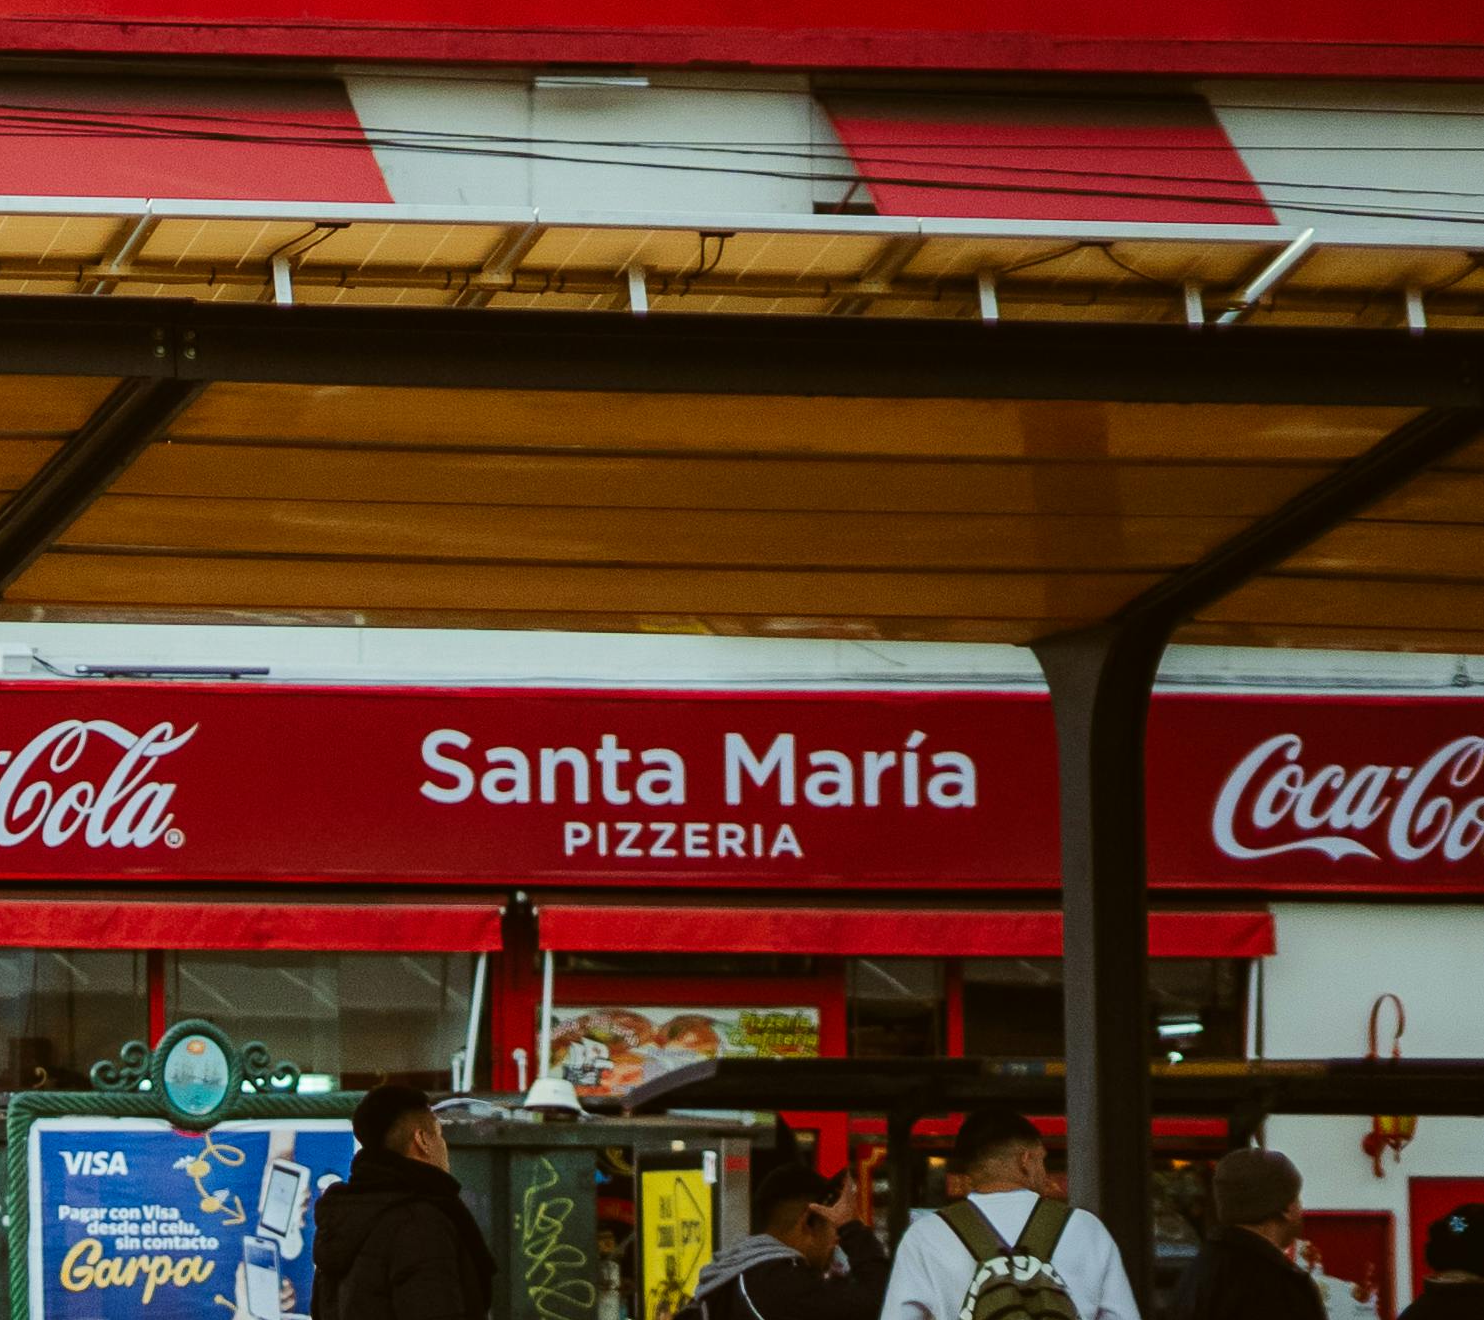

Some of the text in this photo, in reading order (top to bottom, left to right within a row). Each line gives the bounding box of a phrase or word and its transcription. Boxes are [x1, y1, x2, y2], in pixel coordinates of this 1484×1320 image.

[420, 728, 978, 808] Santa María
[564, 821, 804, 859] PIZZERIA
[59, 1151, 129, 1176] VISA
[58, 1205, 181, 1224] Pagar con Visa
[86, 1221, 201, 1237] desde el celu,
[115, 1236, 220, 1251] sin contacto
[60, 1237, 216, 1305] Garpa
